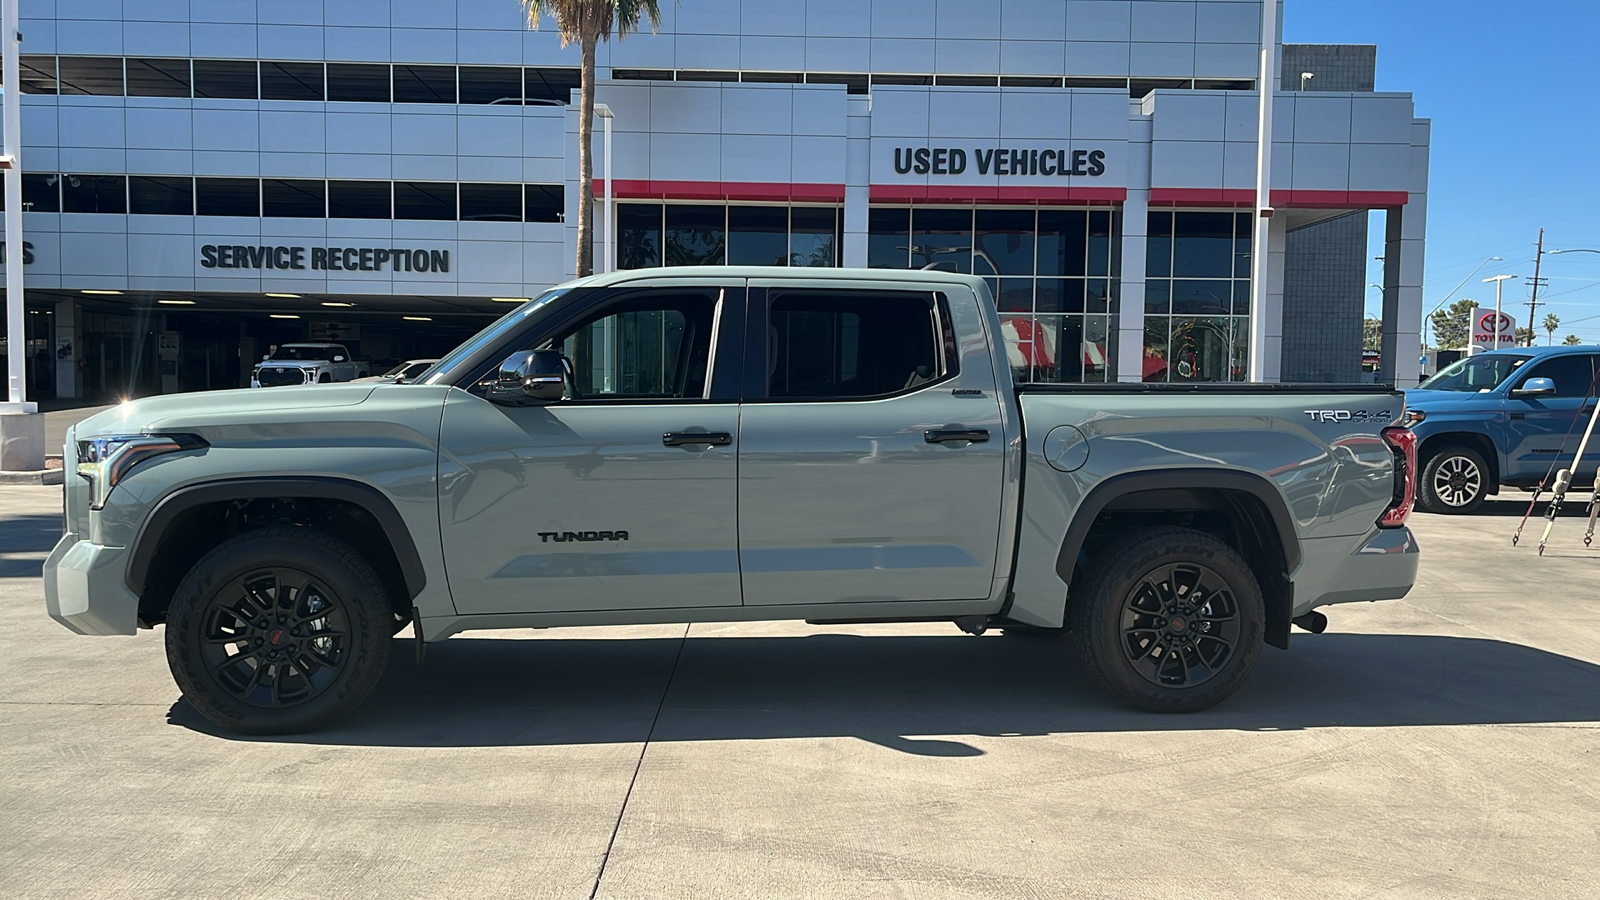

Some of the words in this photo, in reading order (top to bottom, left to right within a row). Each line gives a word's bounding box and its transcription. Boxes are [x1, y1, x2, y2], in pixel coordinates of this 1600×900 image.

[894, 147, 967, 175] USED
[975, 148, 1106, 176] VEHICLES
[200, 244, 306, 270] SERVICE
[311, 246, 449, 273] RECEPTION
[1304, 409, 1352, 424] TRD
[537, 530, 629, 543] TUNDRA
